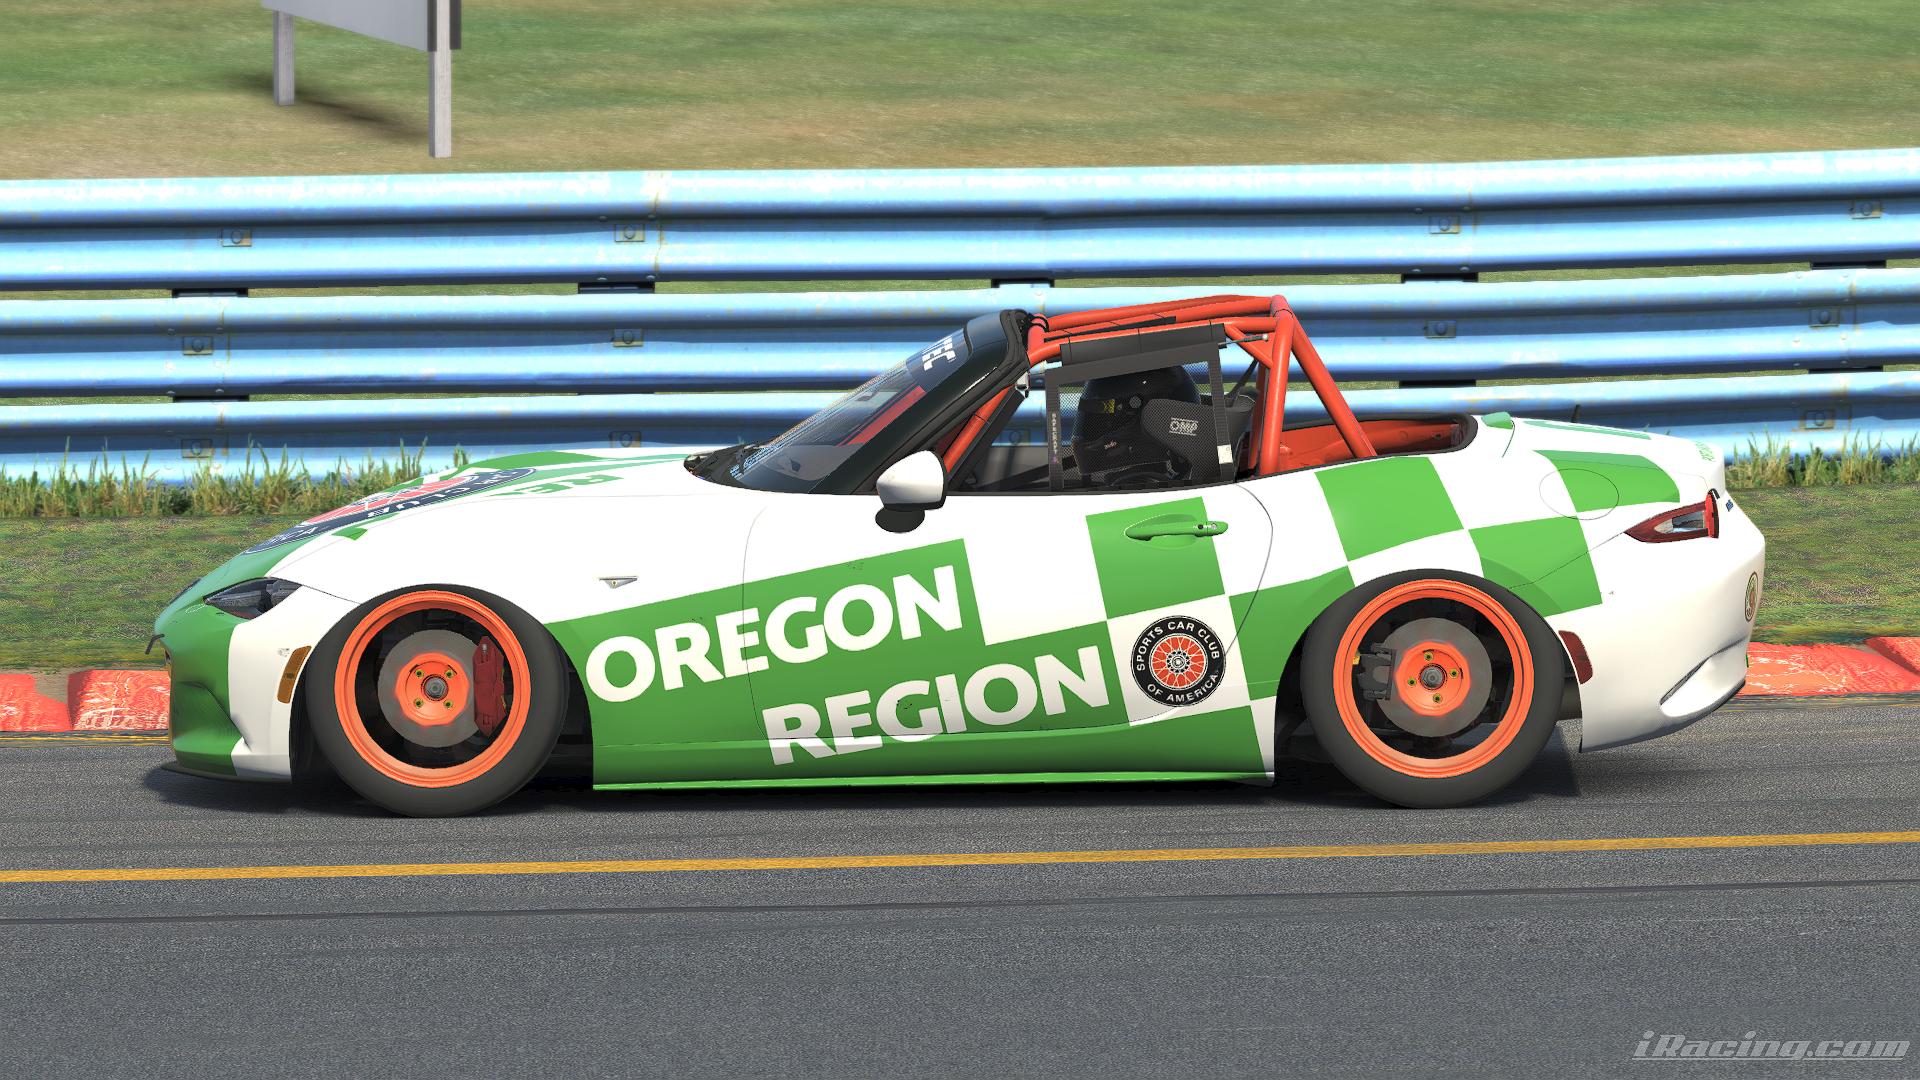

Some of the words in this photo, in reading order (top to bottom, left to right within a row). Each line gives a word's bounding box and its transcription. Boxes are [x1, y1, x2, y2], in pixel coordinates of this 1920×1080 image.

[586, 564, 963, 703] OREGON
[1136, 626, 1164, 671] SPORTS
[1167, 621, 1195, 632] CAR
[1197, 628, 1220, 660] CLUB
[762, 645, 1109, 766] REGION
[1147, 683, 1164, 696] OF
[1166, 673, 1218, 702] AMERICA
